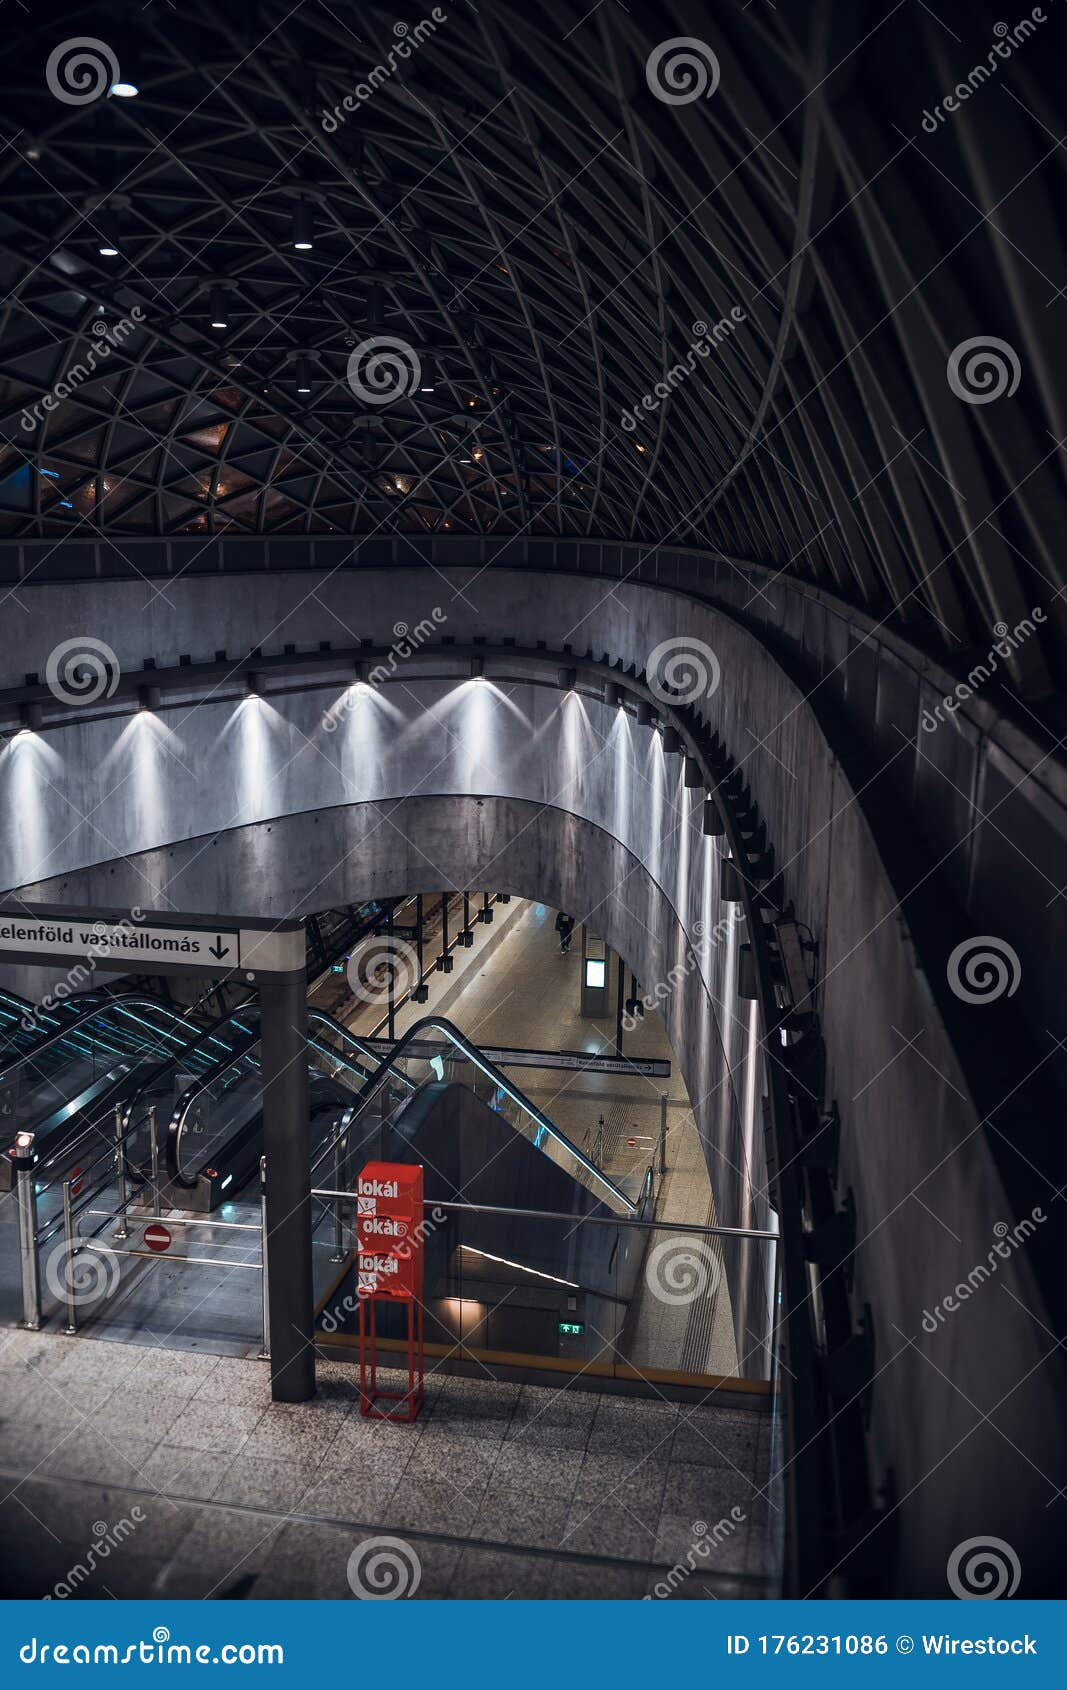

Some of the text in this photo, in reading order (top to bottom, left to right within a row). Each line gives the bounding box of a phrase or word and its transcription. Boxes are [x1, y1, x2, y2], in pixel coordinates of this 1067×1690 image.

[0, 923, 201, 953] elenföld vasútállomás
[358, 1178, 398, 1198] lokál
[359, 1255, 399, 1274] lokál
